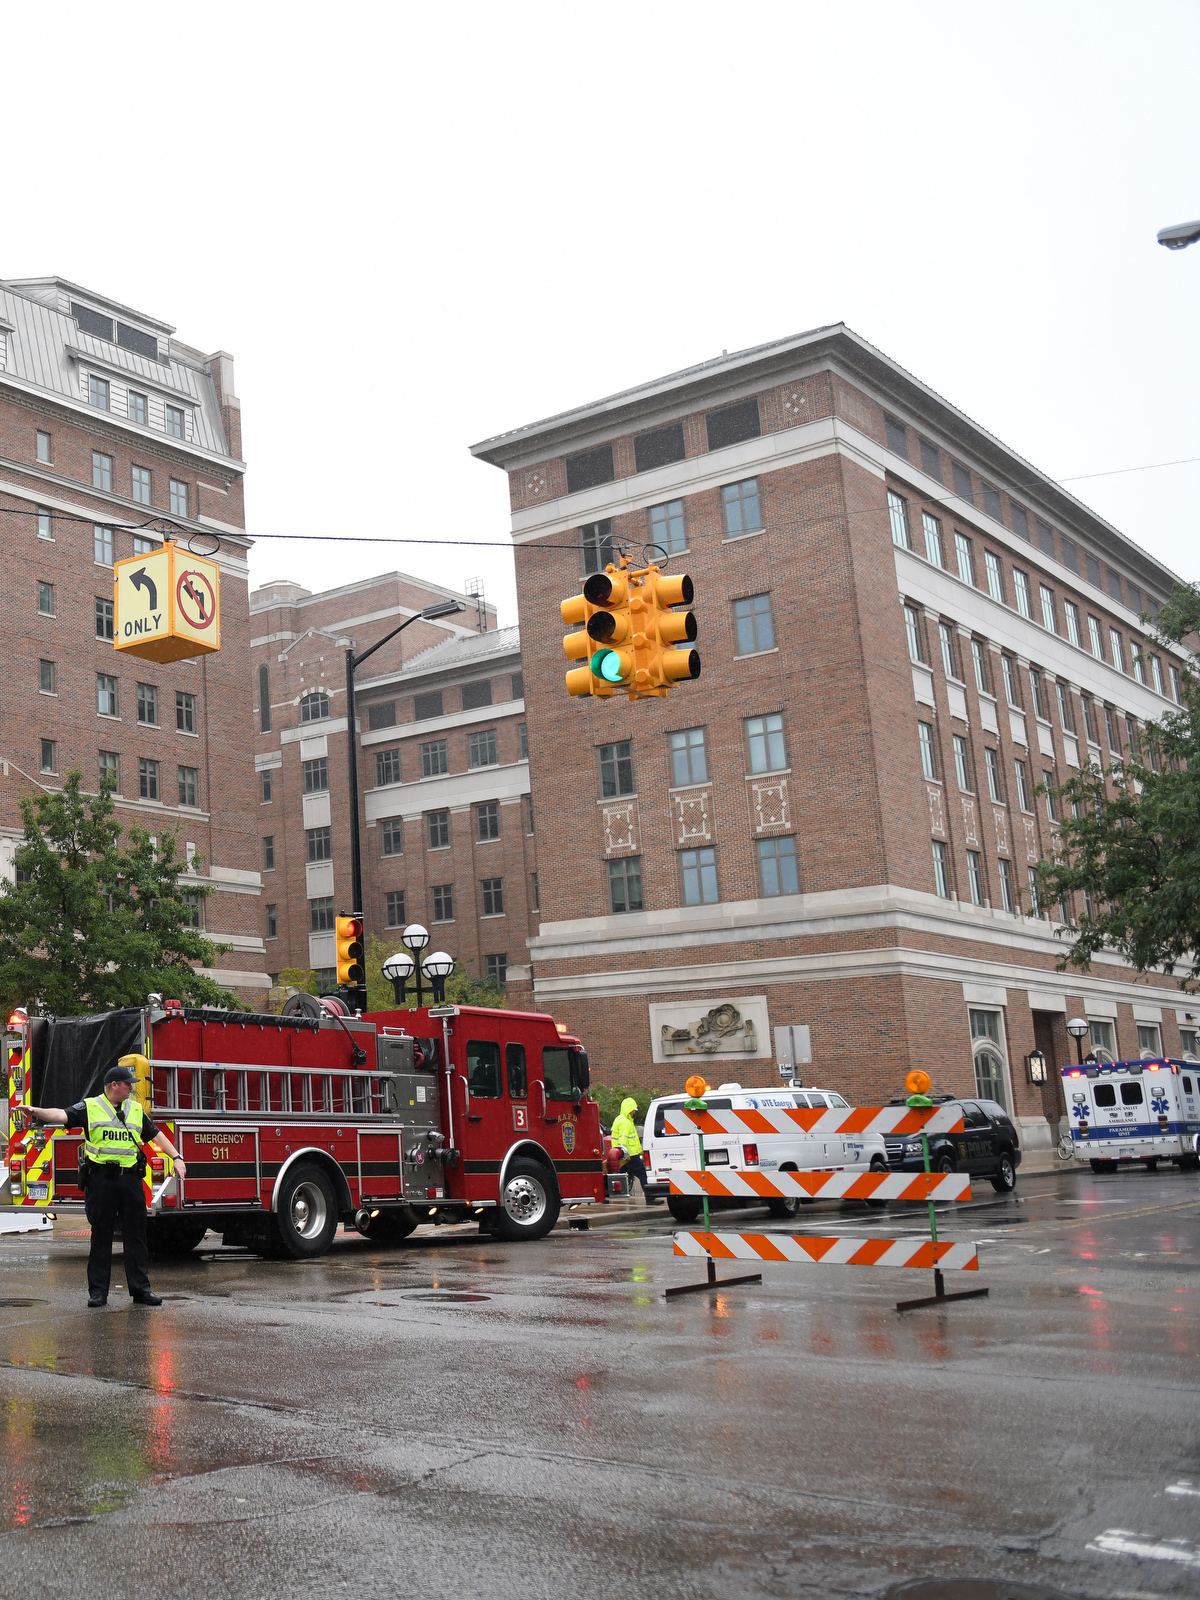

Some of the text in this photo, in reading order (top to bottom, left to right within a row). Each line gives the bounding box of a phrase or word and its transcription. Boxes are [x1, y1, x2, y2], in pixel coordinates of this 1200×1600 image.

[124, 614, 162, 637] ONLY
[761, 1099, 793, 1108] DTE Energy
[517, 1110, 524, 1126] 3
[102, 1130, 133, 1141] POLICE
[194, 1134, 245, 1144] EMERGENCY
[212, 1147, 229, 1160] 911
[968, 1141, 993, 1158] POLICE
